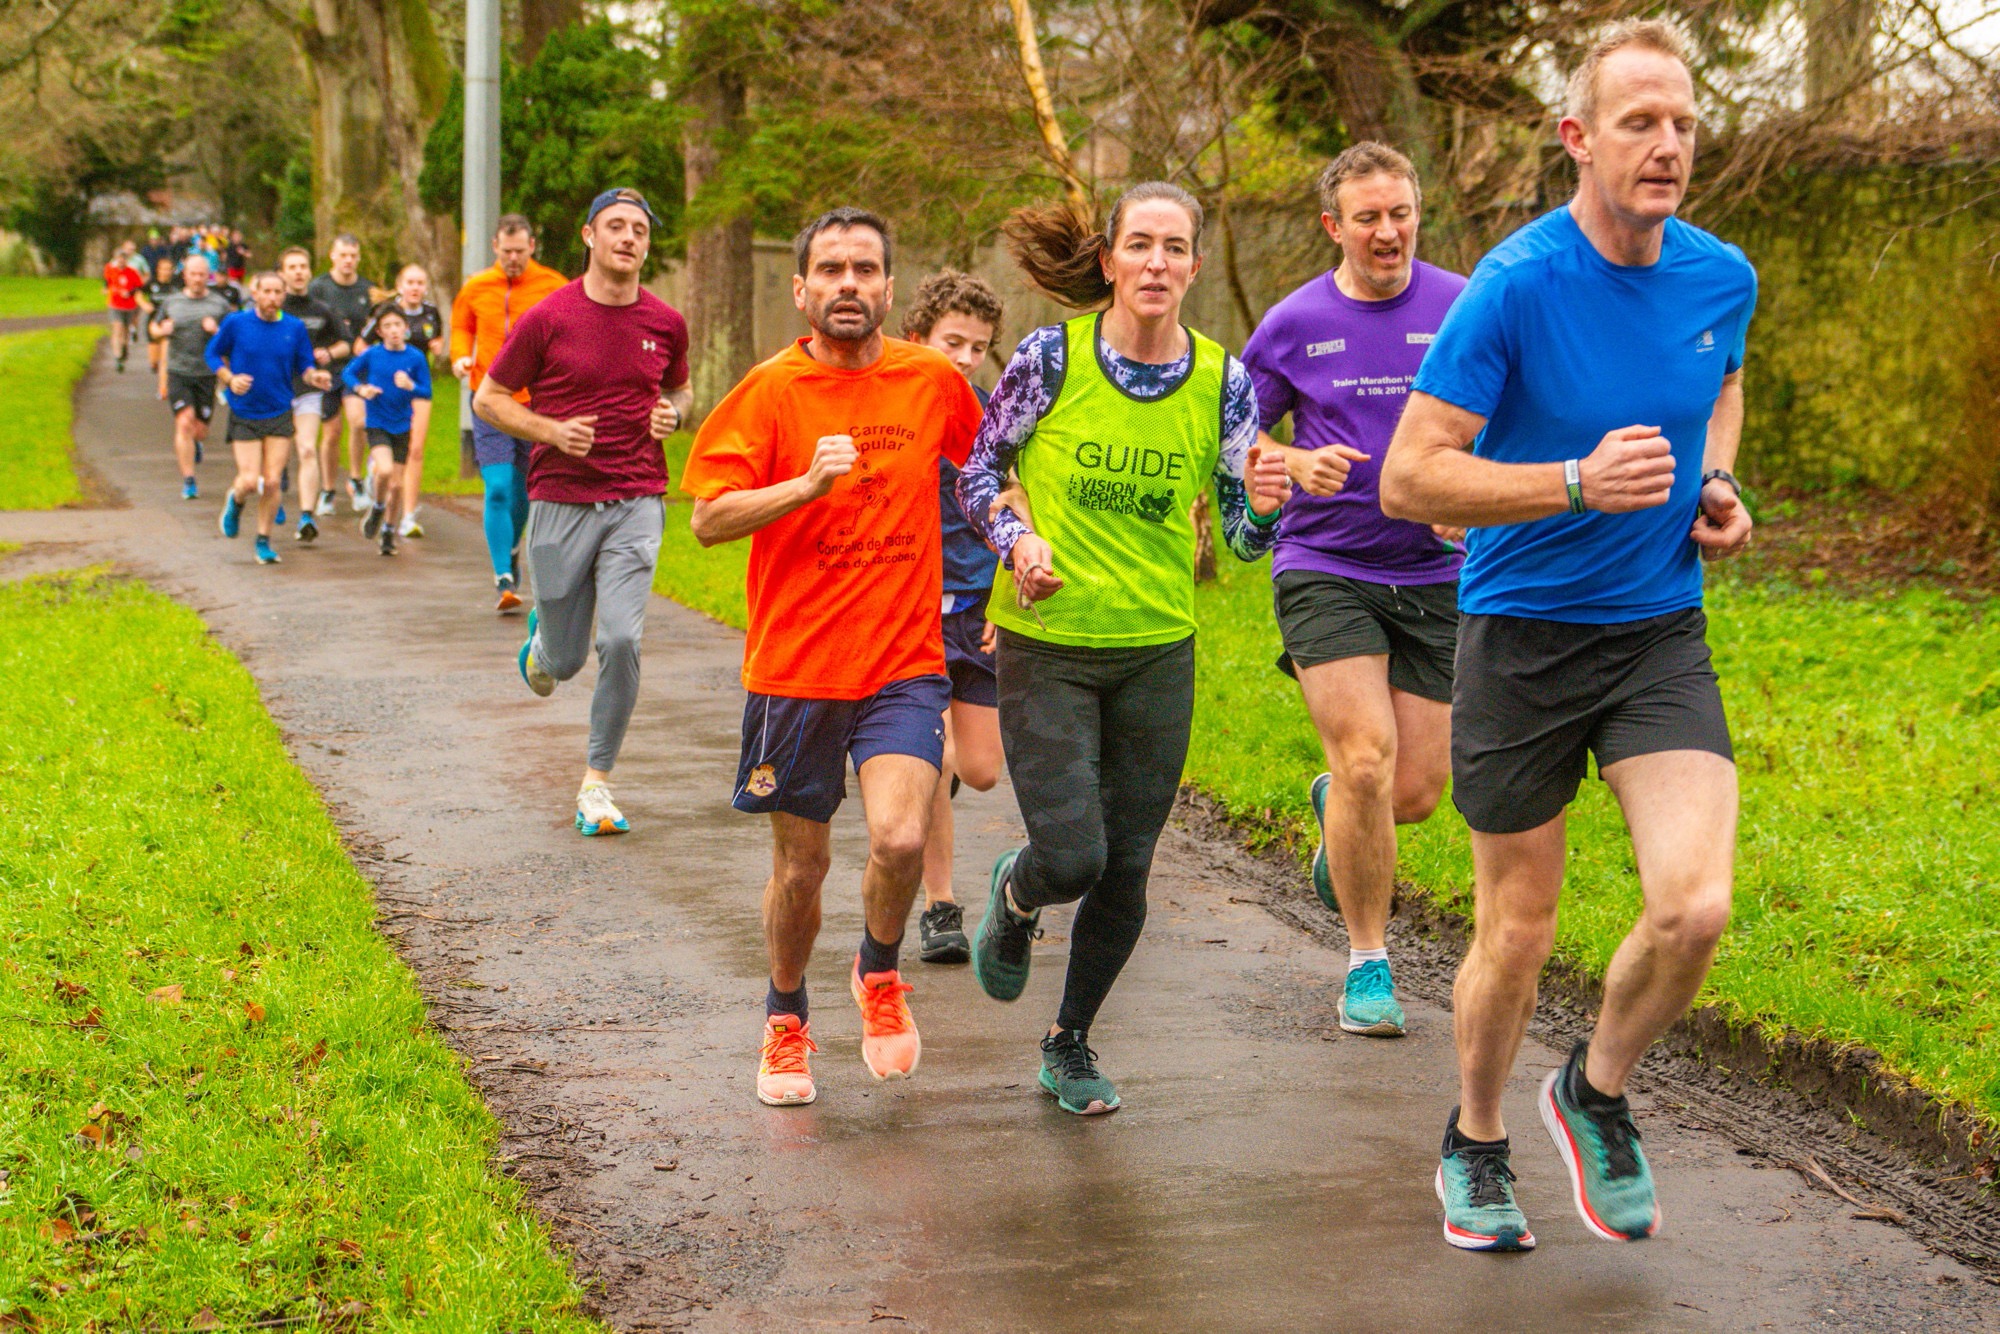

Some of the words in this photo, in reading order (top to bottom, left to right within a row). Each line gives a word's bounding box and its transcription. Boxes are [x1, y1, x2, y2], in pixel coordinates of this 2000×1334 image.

[1332, 379, 1358, 388] Tralee
[1359, 376, 1403, 385] Marathon
[1404, 374, 1416, 383] Ha
[1356, 388, 1366, 396] &
[1367, 387, 1383, 395] 10k
[1384, 386, 1407, 395] 2019
[848, 424, 915, 441] Carreira
[854, 437, 905, 455] pular
[1075, 441, 1186, 480] GUIDE
[1080, 476, 1137, 497] VISION
[1079, 488, 1136, 507] SPORTS
[1079, 499, 1134, 515] IRELAND
[866, 537, 881, 551] de
[853, 557, 869, 568] do
